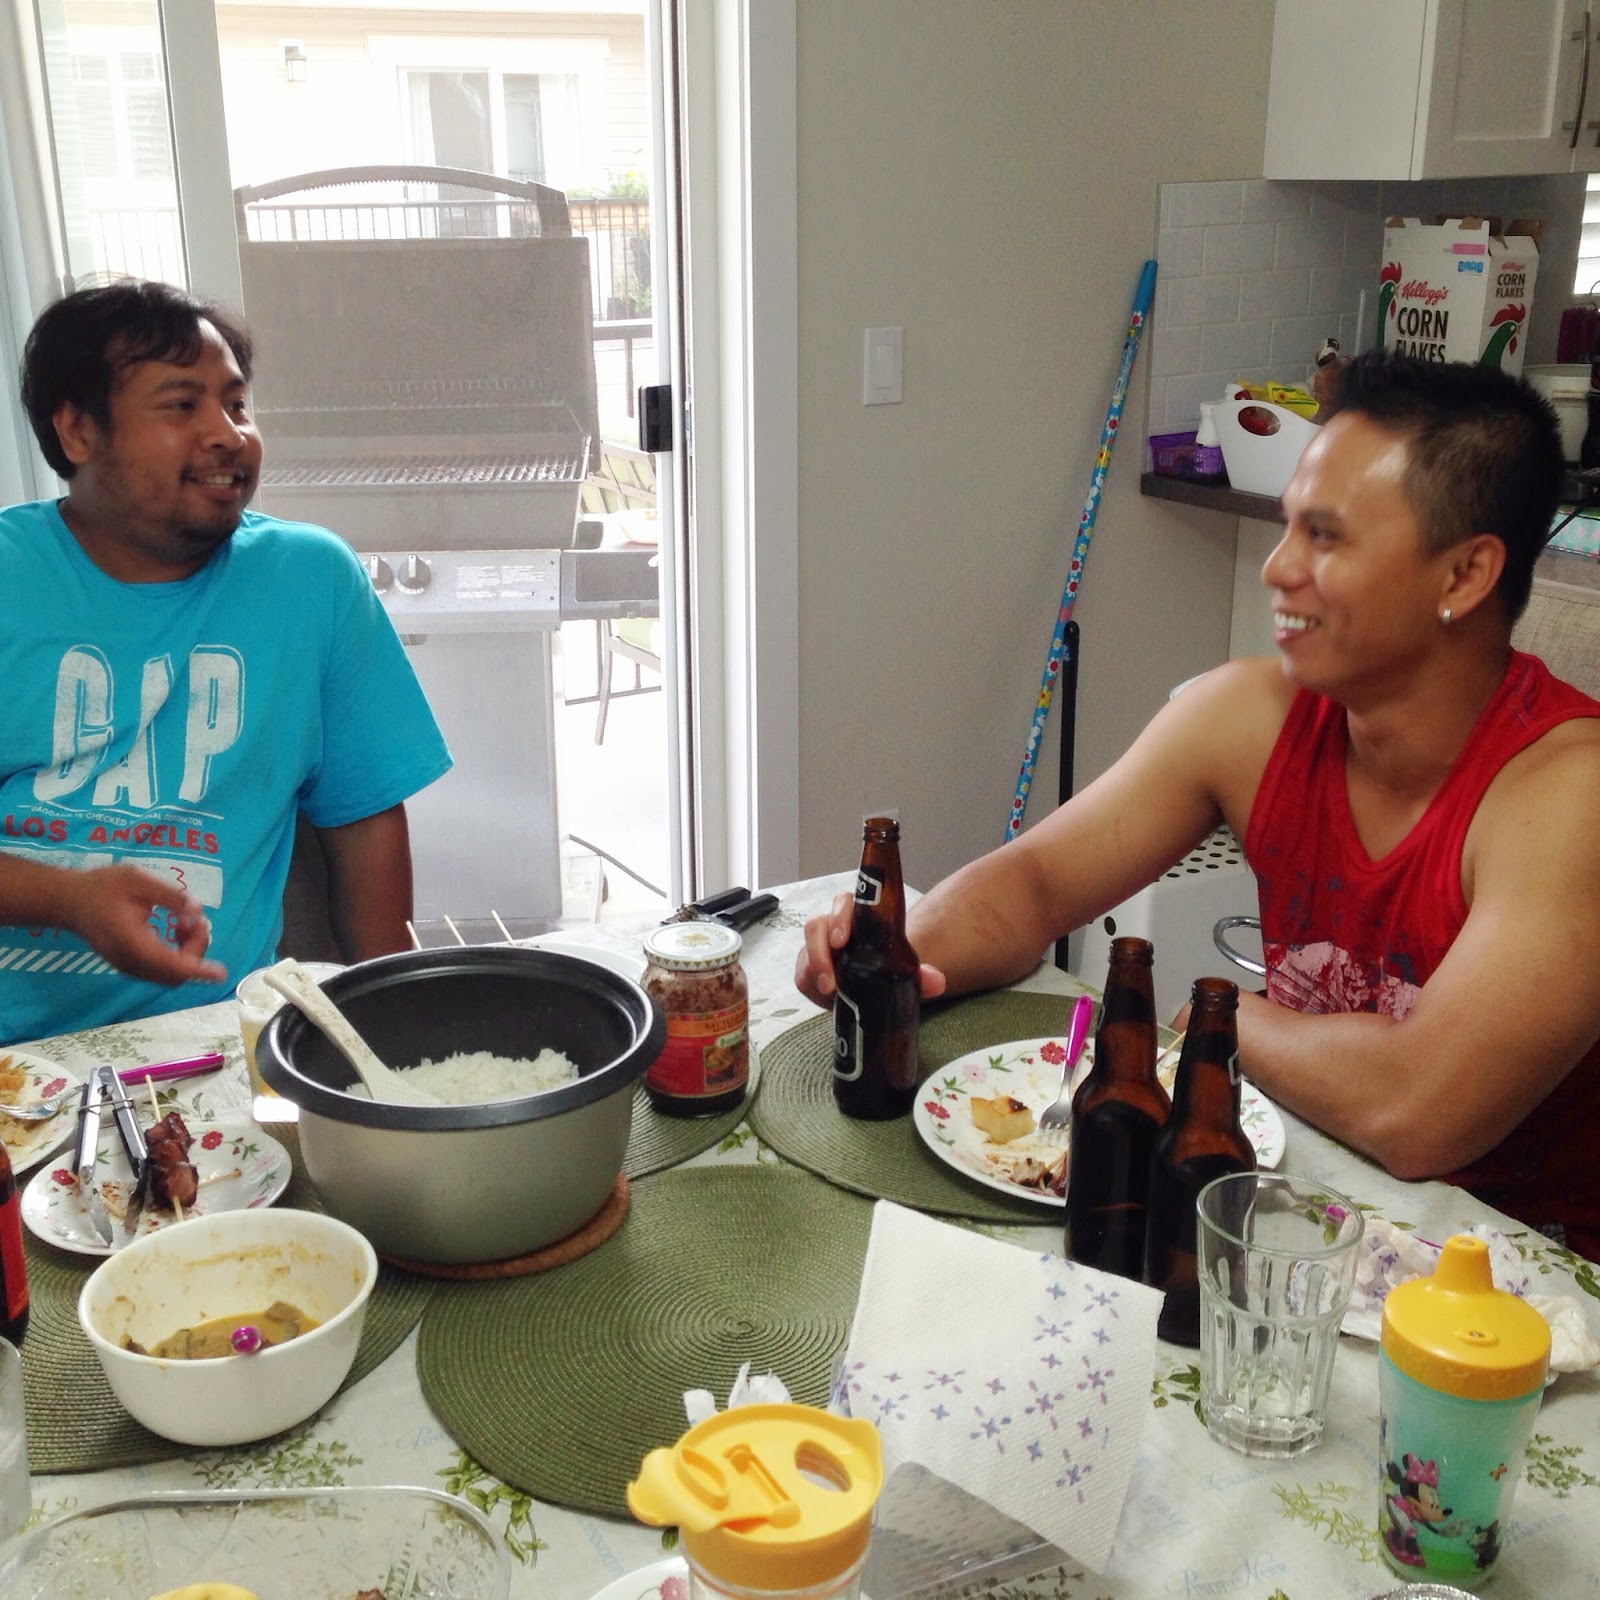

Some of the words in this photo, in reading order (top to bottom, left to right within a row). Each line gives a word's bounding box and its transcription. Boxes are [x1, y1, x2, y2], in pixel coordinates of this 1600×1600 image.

[1402, 279, 1449, 306] Kellogg's
[1495, 286, 1524, 298] FLAKES
[1497, 273, 1526, 286] CORN
[1398, 307, 1449, 339] CORN
[33, 644, 246, 809] GAP
[85, 812, 127, 827] CHECKED
[4, 814, 68, 843] LOS
[87, 823, 220, 855] ANGELES
